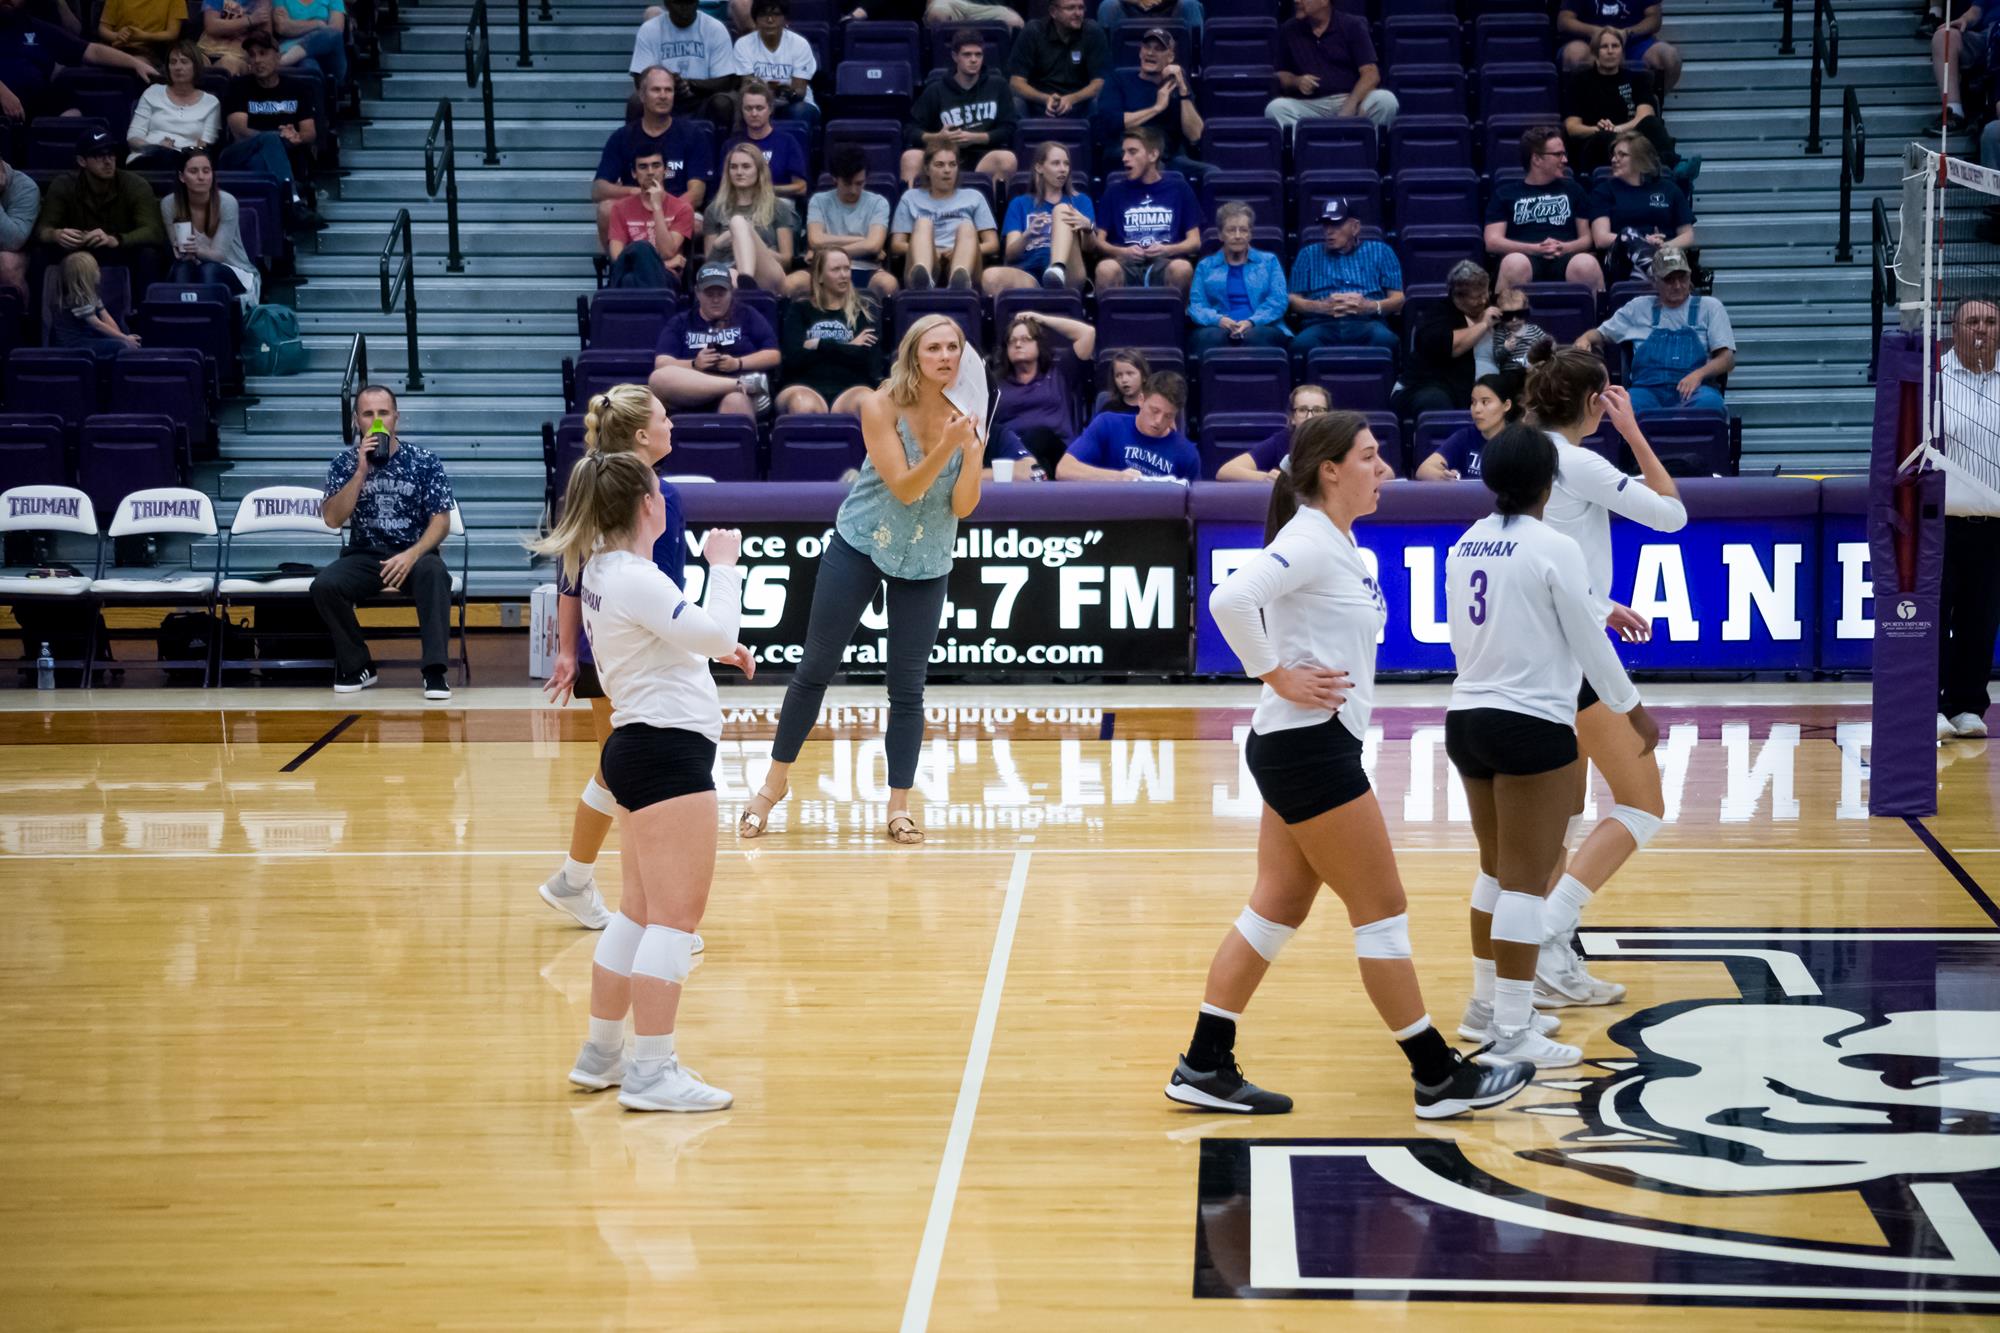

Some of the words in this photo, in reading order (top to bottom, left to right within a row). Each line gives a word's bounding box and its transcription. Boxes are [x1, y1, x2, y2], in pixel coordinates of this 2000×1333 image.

[1124, 212, 1173, 227] TRUMAN
[1124, 446, 1173, 474] TRUMAN
[7, 496, 81, 519] TRUMAN
[131, 498, 200, 521] TRUMAN
[253, 498, 324, 519] TRUMAN
[1457, 541, 1518, 557] TRUMAN
[1059, 565, 1175, 630] FM
[1469, 570, 1487, 626] 3
